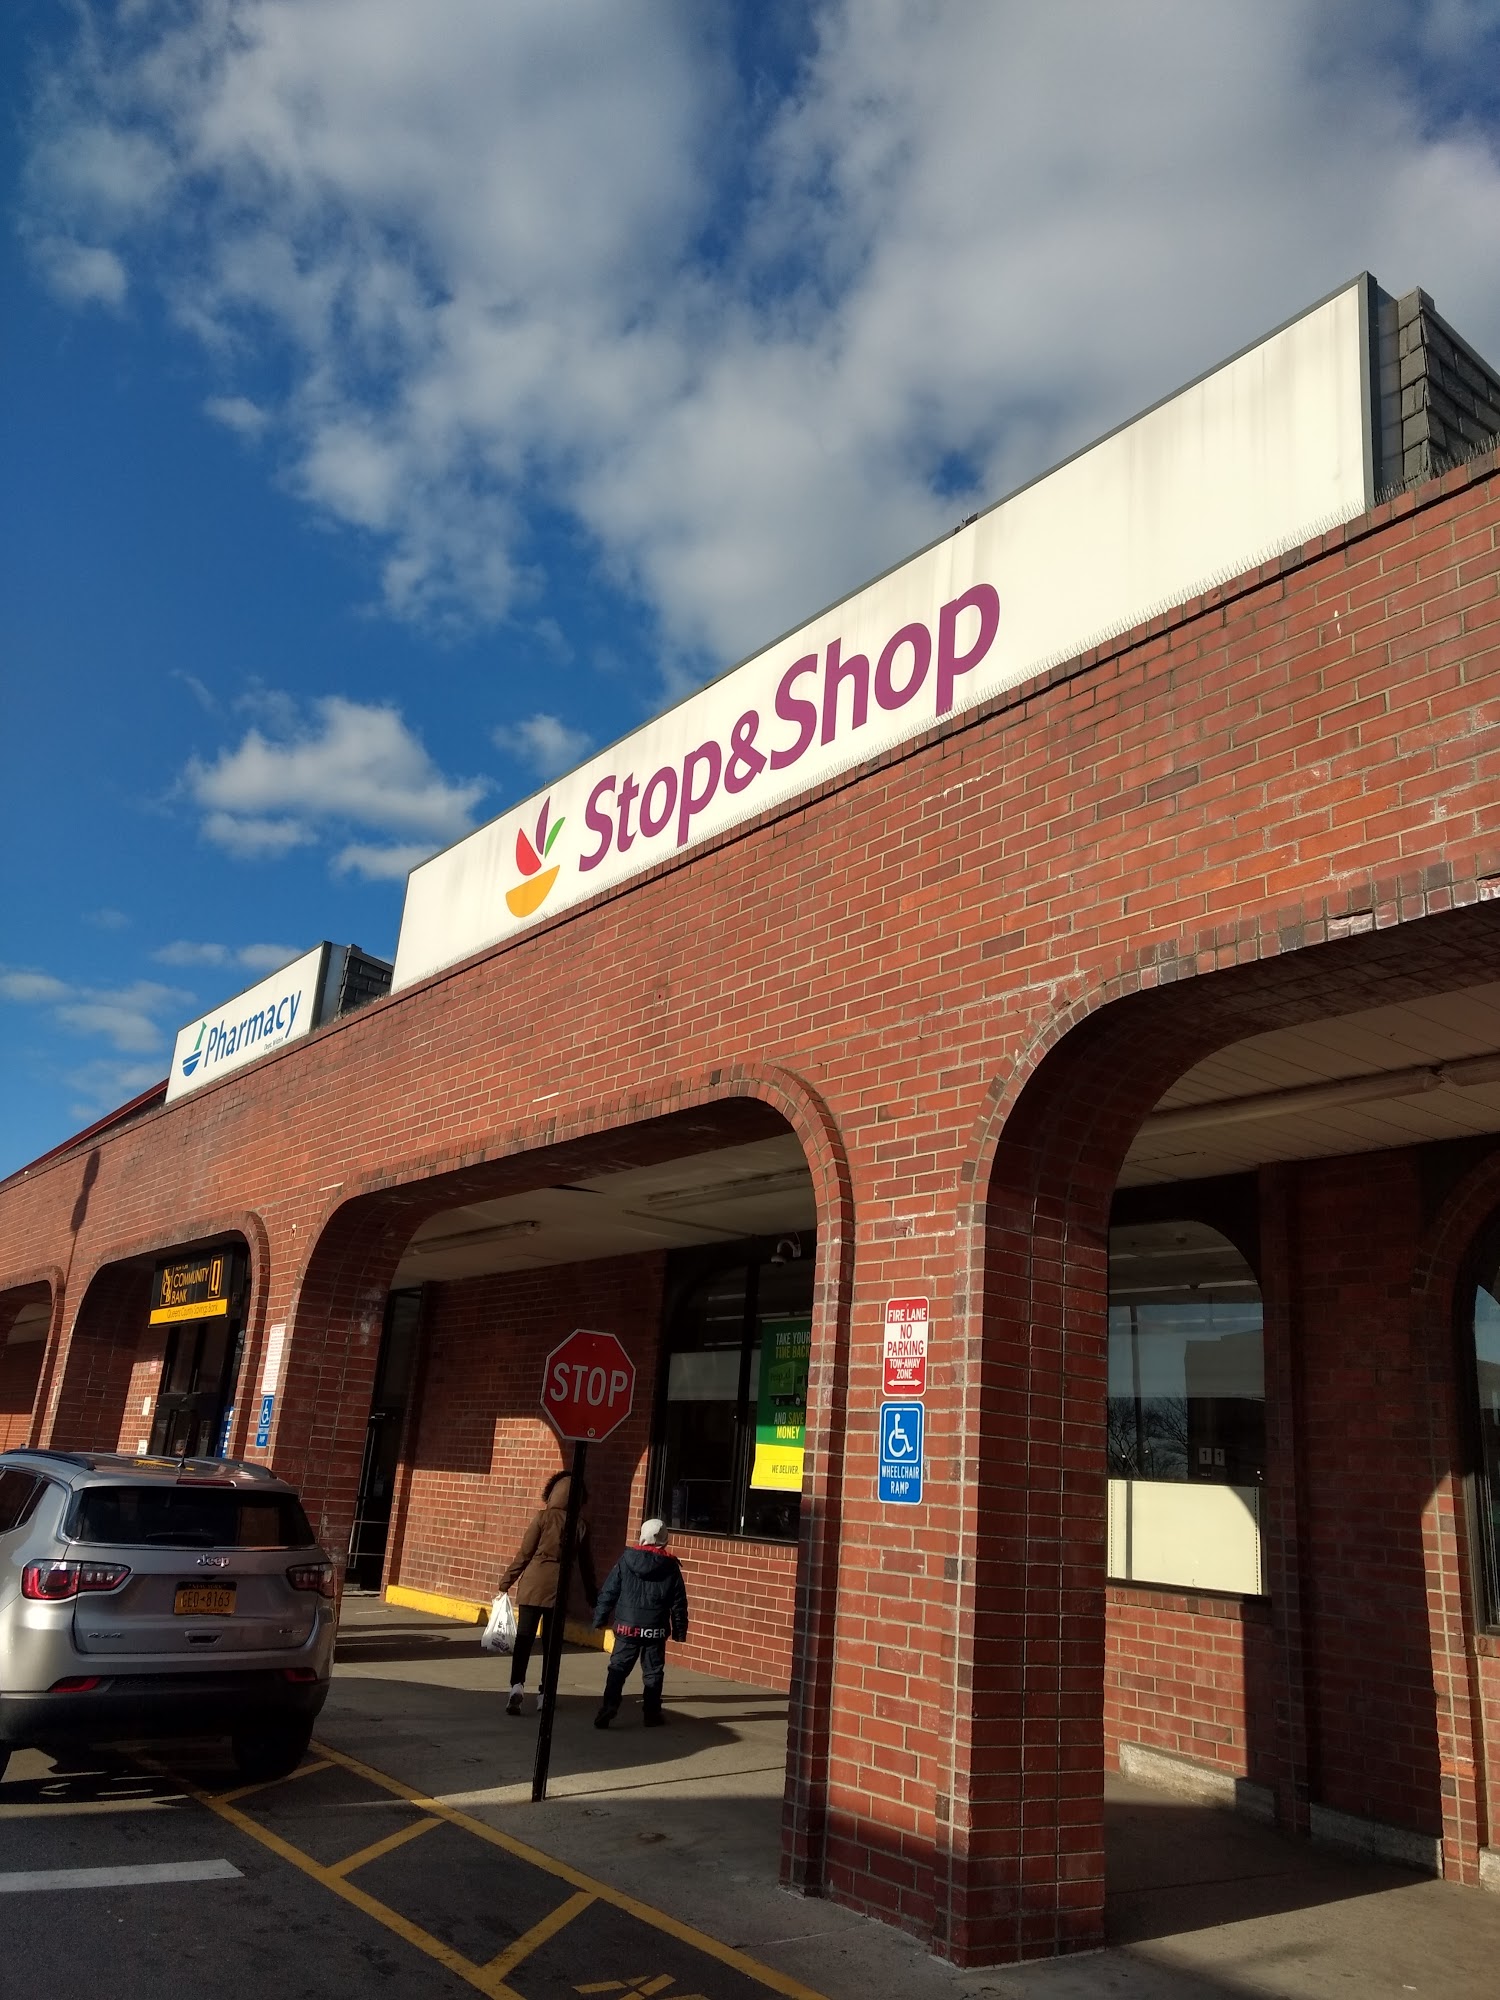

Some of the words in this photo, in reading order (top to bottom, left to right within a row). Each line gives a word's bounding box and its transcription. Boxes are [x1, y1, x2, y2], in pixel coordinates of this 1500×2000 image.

[579, 583, 1000, 872] Stop&Shop
[203, 990, 302, 1068] Pharmacy
[173, 1267, 209, 1288] COMMUNITY
[171, 1288, 188, 1304] BANK
[888, 1309, 905, 1322] FIRE
[906, 1308, 927, 1321] LANE
[776, 1333, 791, 1345] TAKE
[793, 1331, 811, 1344] YOUR
[900, 1324, 912, 1339] NO
[776, 1347, 791, 1359] TIME
[793, 1346, 810, 1358] BACK
[887, 1340, 924, 1356] PARKING
[889, 1358, 921, 1369] TOW-AWAY
[896, 1369, 913, 1379] ZONE
[550, 1362, 628, 1408] STOP
[774, 1412, 787, 1425] AND
[788, 1412, 804, 1425] SAVE
[776, 1425, 800, 1439] MONEY
[771, 1464, 778, 1474] WE
[881, 1465, 920, 1480] WHEELCHAIR
[890, 1480, 910, 1495] RAMP
[196, 1553, 230, 1568] Jeep
[616, 1623, 666, 1639] HILFIGER
